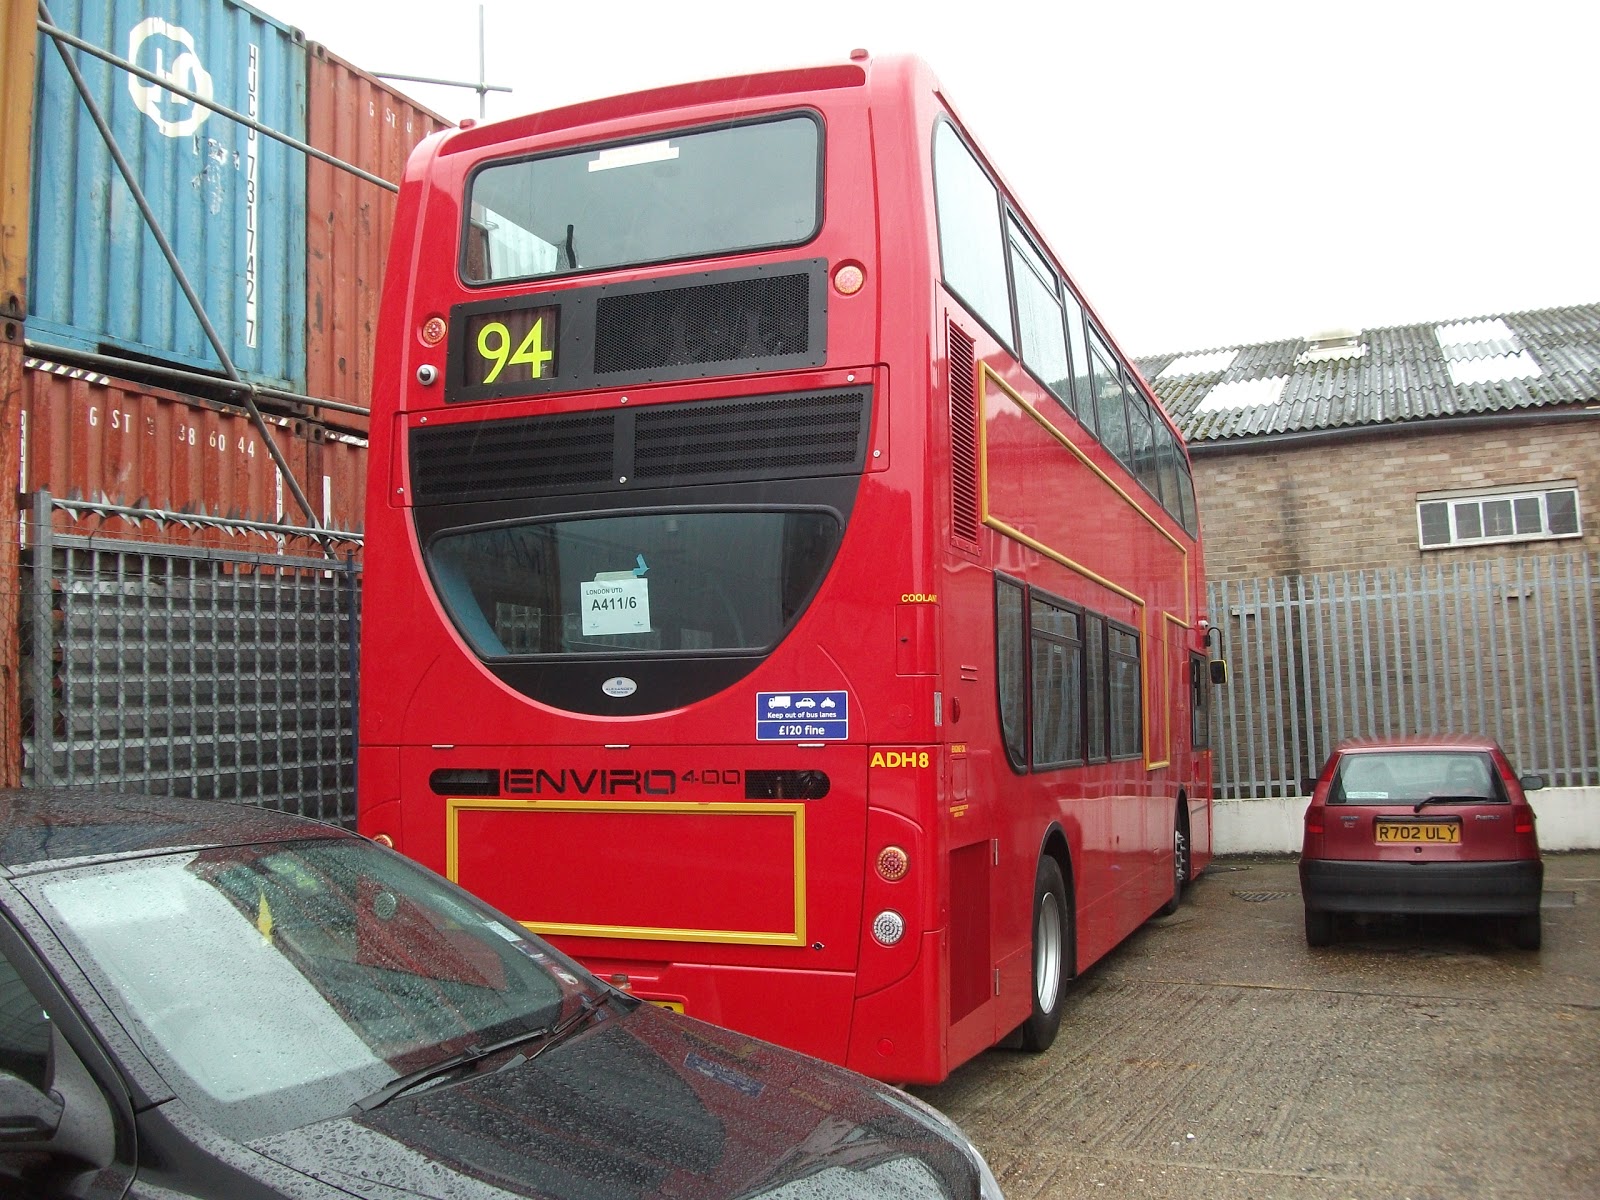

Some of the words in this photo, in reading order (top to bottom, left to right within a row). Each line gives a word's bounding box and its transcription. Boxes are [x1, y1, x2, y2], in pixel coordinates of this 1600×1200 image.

[476, 316, 553, 385] 94
[591, 596, 637, 611] A411/6
[767, 711, 784, 719] Keep
[785, 711, 797, 719] out
[778, 725, 802, 735] £120
[804, 725, 825, 735] fine
[870, 752, 930, 768] ADH8
[504, 768, 677, 795] ENVIRO
[681, 769, 741, 785] 400
[1379, 826, 1421, 840] R702
[1425, 826, 1457, 840] ULY
